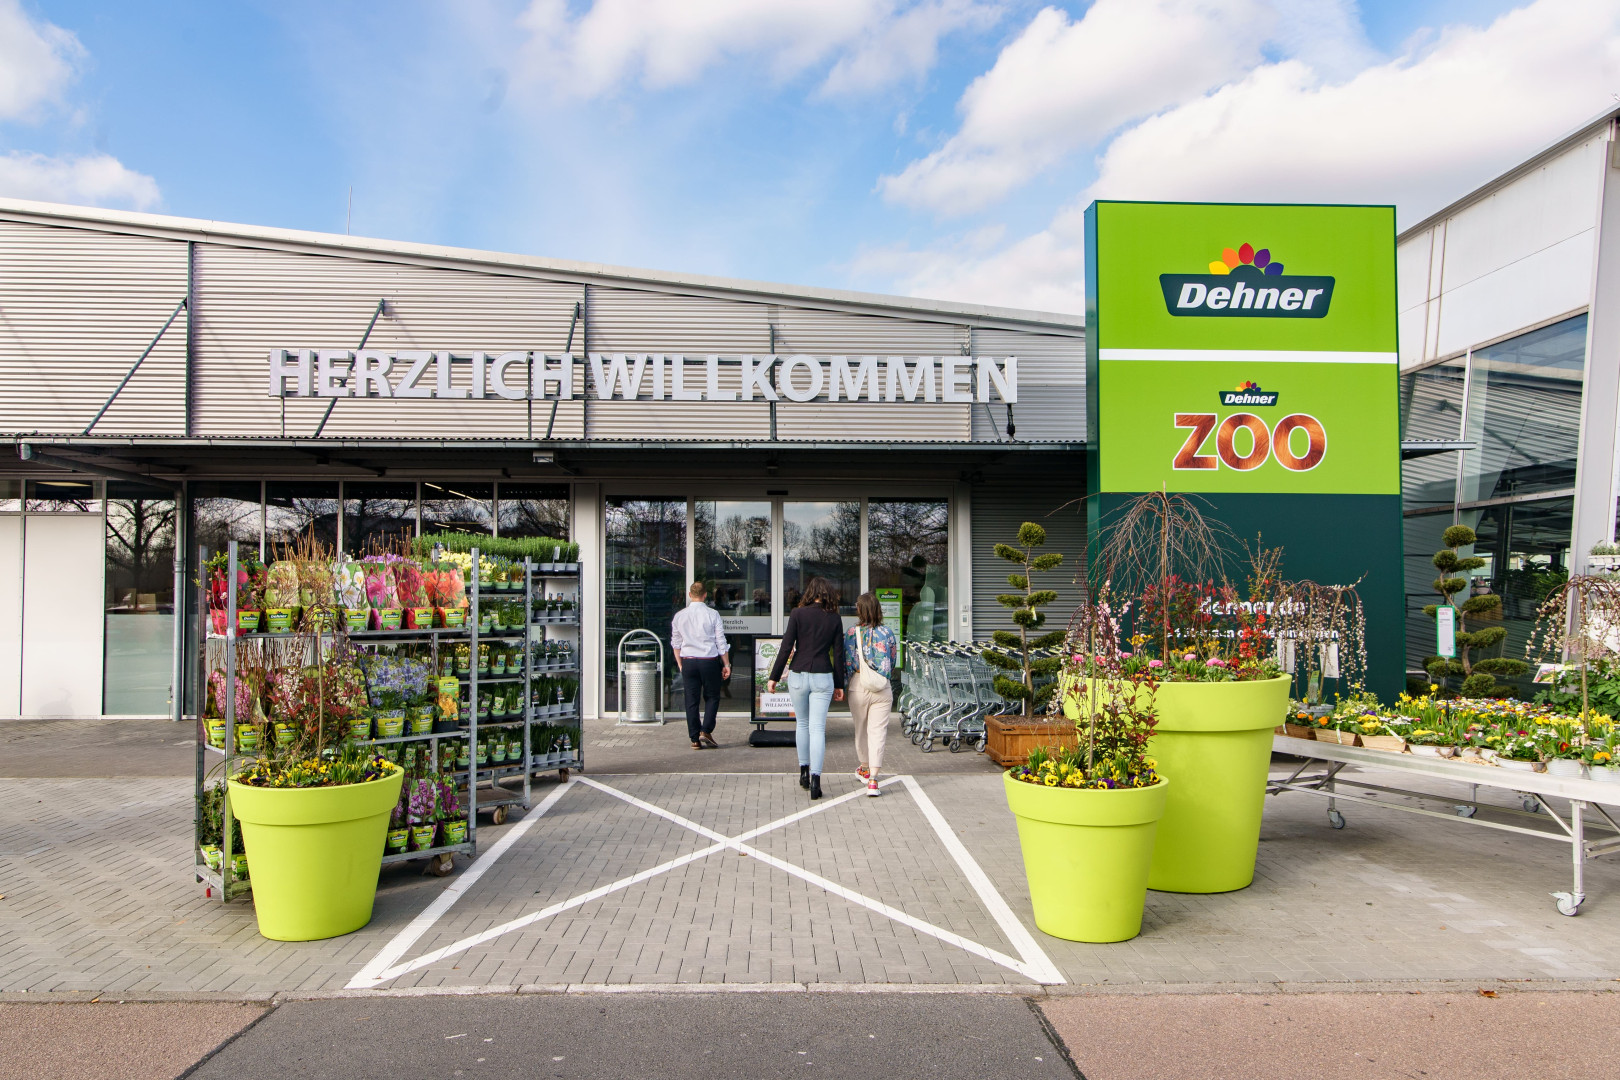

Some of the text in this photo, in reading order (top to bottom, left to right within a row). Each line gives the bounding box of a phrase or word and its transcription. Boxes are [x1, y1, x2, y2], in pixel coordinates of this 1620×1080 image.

[1176, 281, 1324, 310] Dehner
[269, 349, 1018, 403] HERZLICH WILLKOMMEN
[1224, 393, 1276, 405] Dehner
[1172, 412, 1327, 472] ZOO
